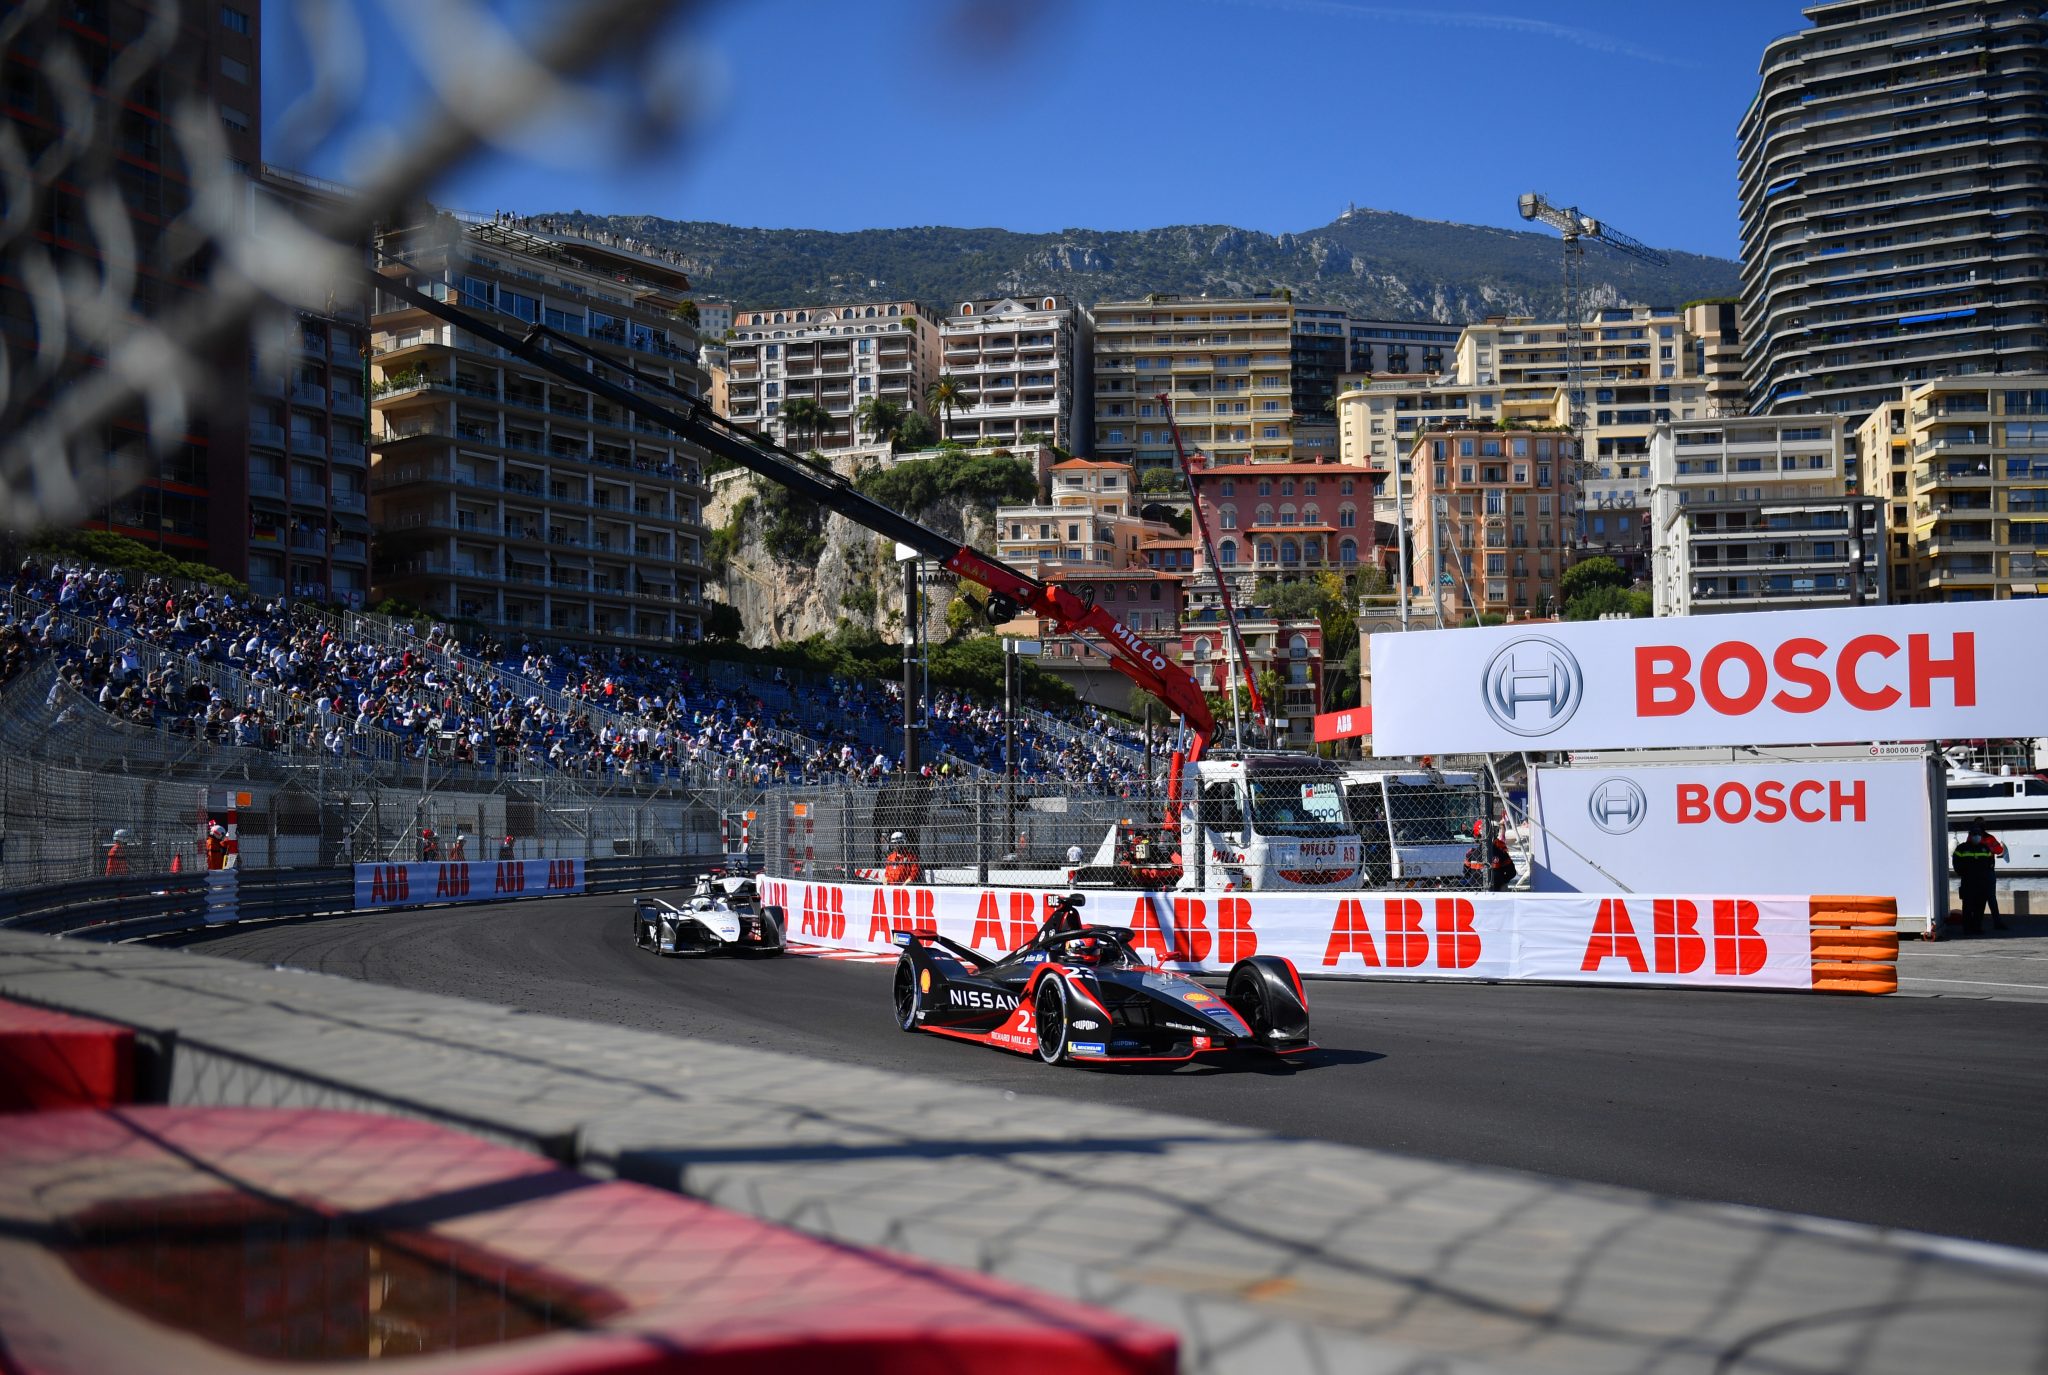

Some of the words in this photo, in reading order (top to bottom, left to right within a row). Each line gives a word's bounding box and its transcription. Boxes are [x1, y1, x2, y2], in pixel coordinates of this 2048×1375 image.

[1112, 623, 1166, 670] MILLO
[1635, 632, 1976, 717] BOSCH
[1336, 714, 1352, 733] ABB
[1677, 780, 1867, 823] BOSCH
[371, 866, 409, 903] ABB
[436, 864, 469, 898] ABB
[495, 861, 524, 893] ABB
[548, 859, 575, 889] ABB
[801, 885, 846, 940] ABB
[868, 888, 937, 947] ABB
[1047, 895, 1060, 906] BUE
[1128, 896, 1258, 964] ABB
[1322, 898, 1482, 968] ABB
[1580, 899, 1767, 975] ABB
[950, 989, 1020, 1011] NISSAN
[1011, 1035, 1032, 1046] MILLE
[1075, 1020, 1096, 1031] DUPONT
